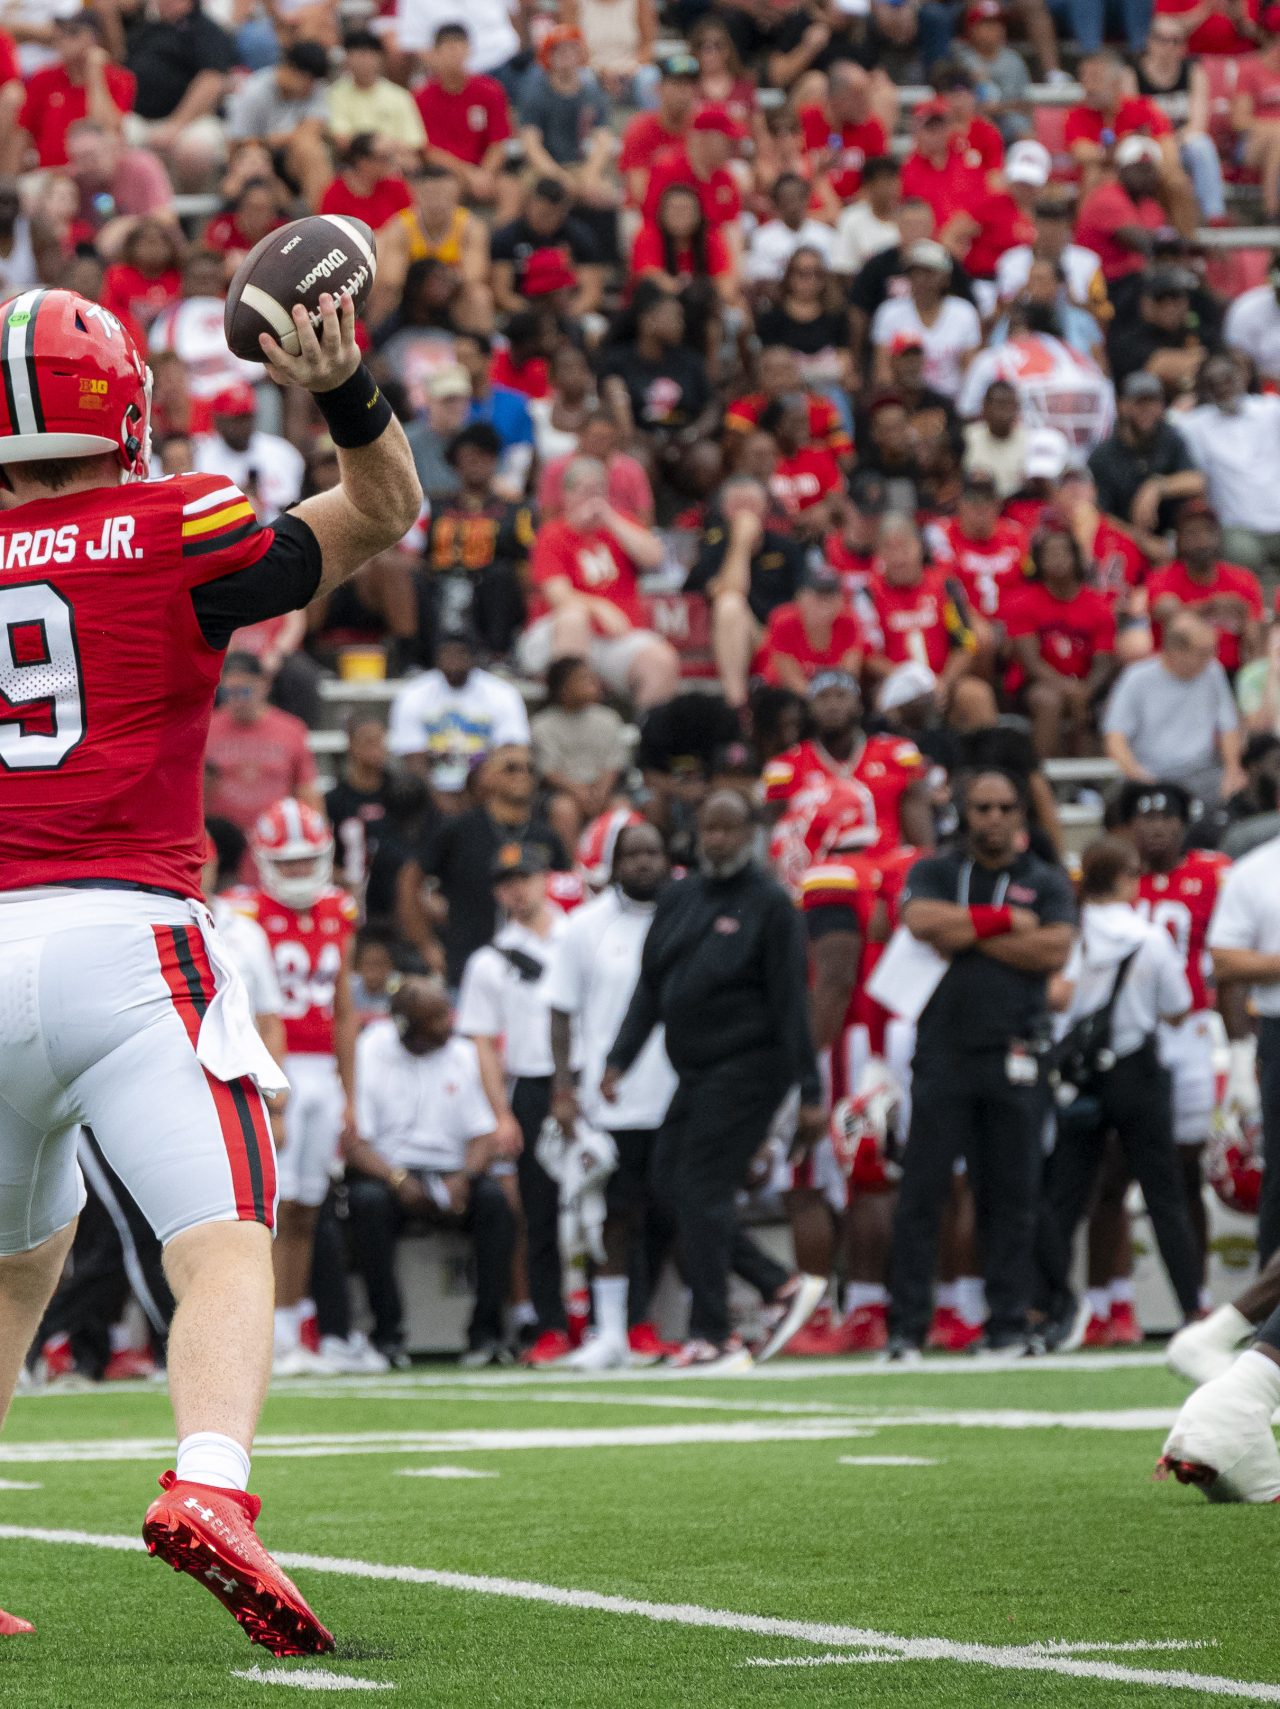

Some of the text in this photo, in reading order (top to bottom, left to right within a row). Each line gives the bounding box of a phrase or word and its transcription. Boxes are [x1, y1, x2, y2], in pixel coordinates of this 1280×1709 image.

[280, 235, 303, 256] NCAA
[295, 248, 349, 294] Wilson
[85, 514, 144, 561] JR.
